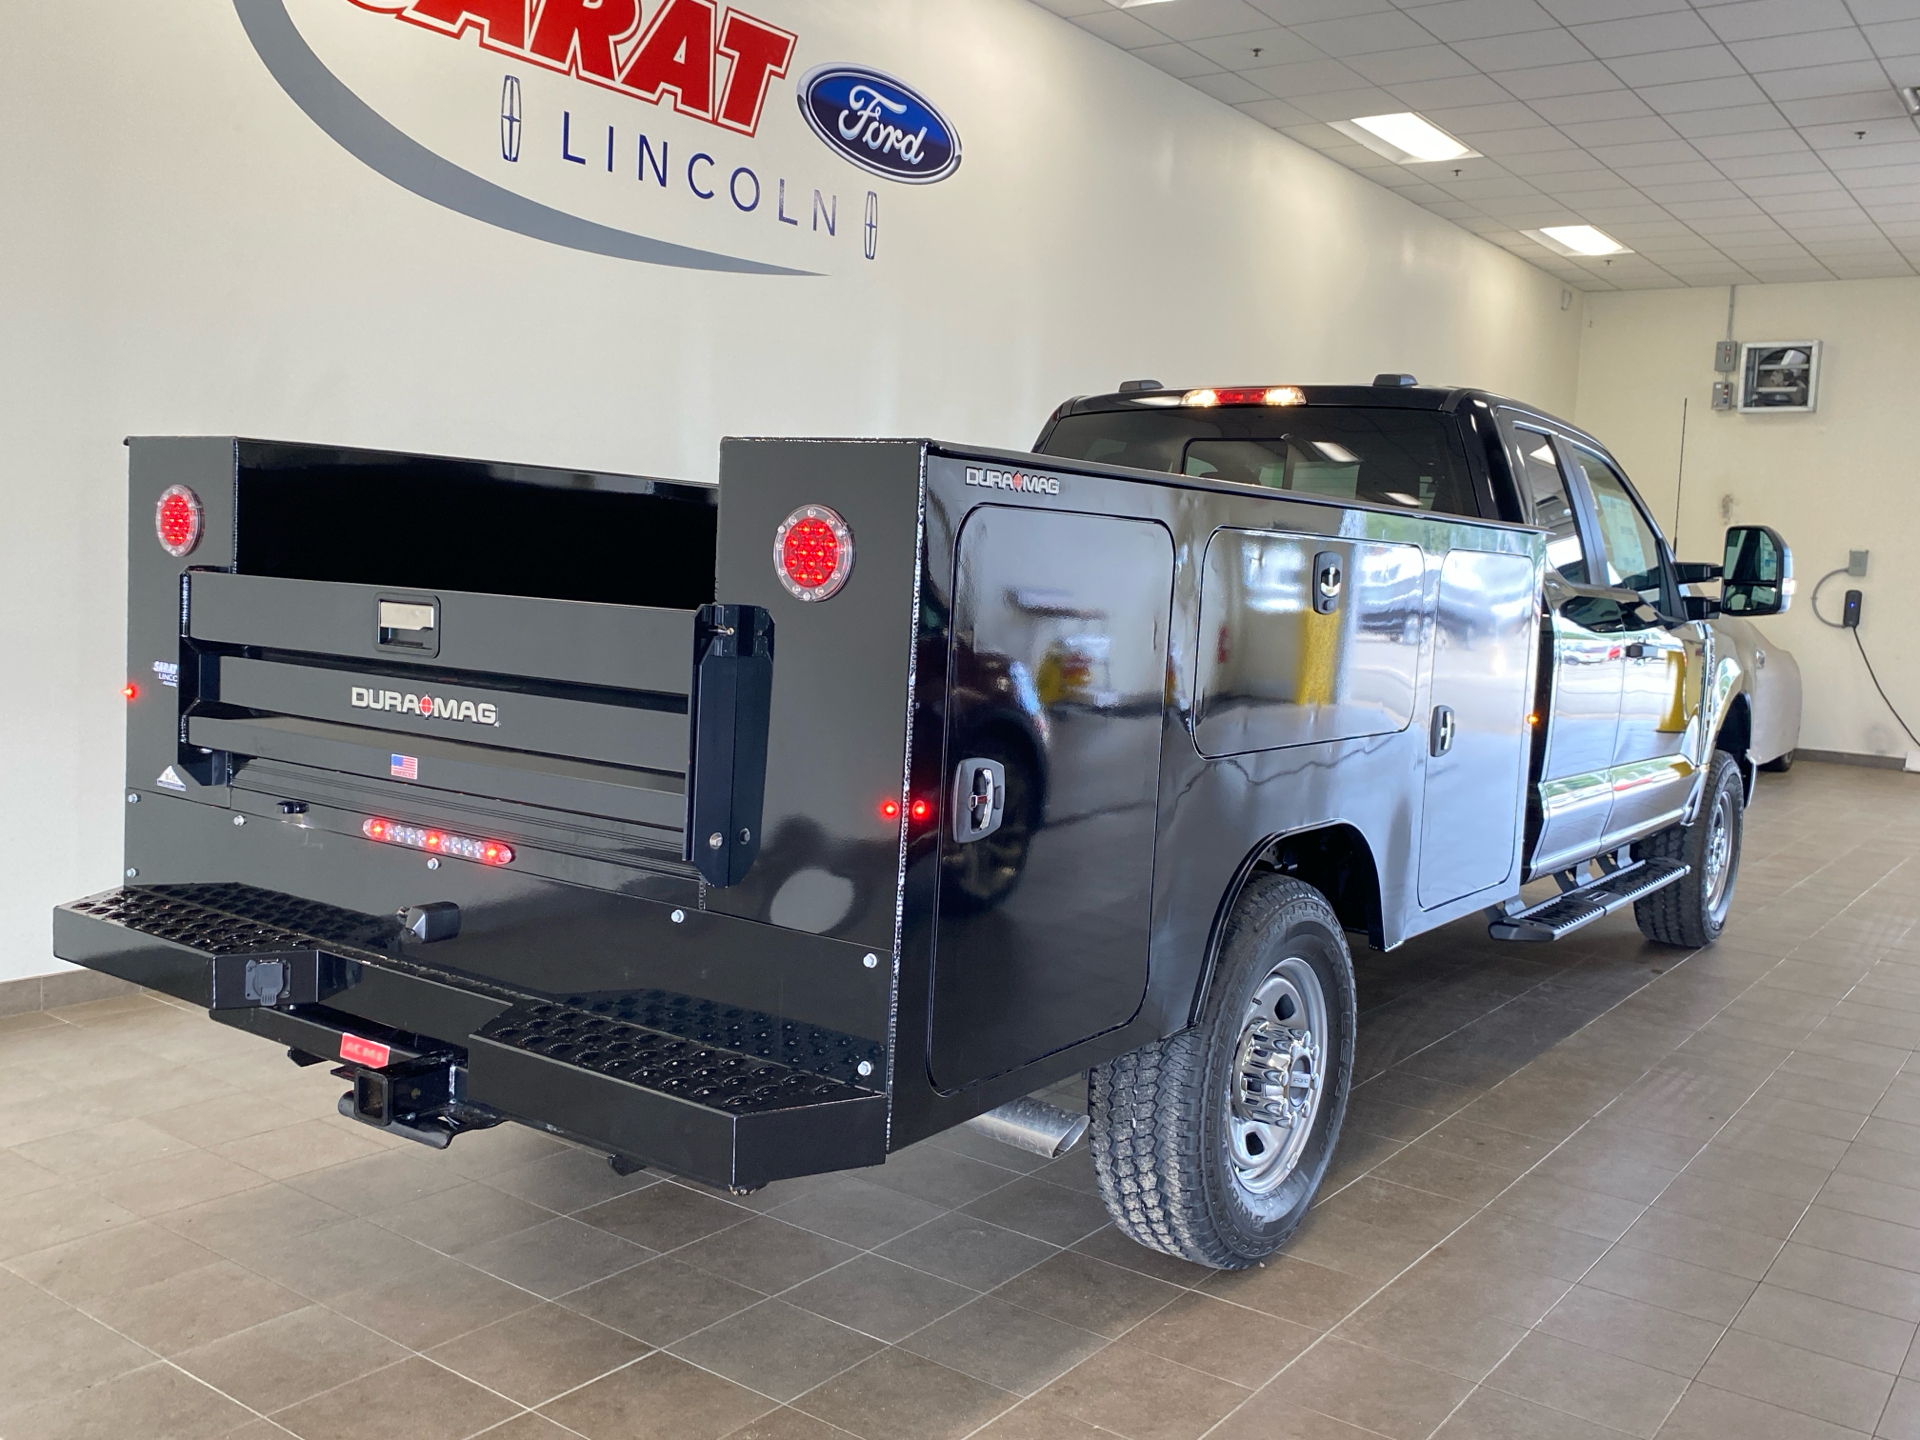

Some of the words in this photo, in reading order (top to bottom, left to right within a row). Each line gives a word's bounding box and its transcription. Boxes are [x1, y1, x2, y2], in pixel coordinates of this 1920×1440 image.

[345, 0, 798, 137] RAT
[838, 85, 928, 165] Ford
[562, 111, 837, 237] LINCOLN
